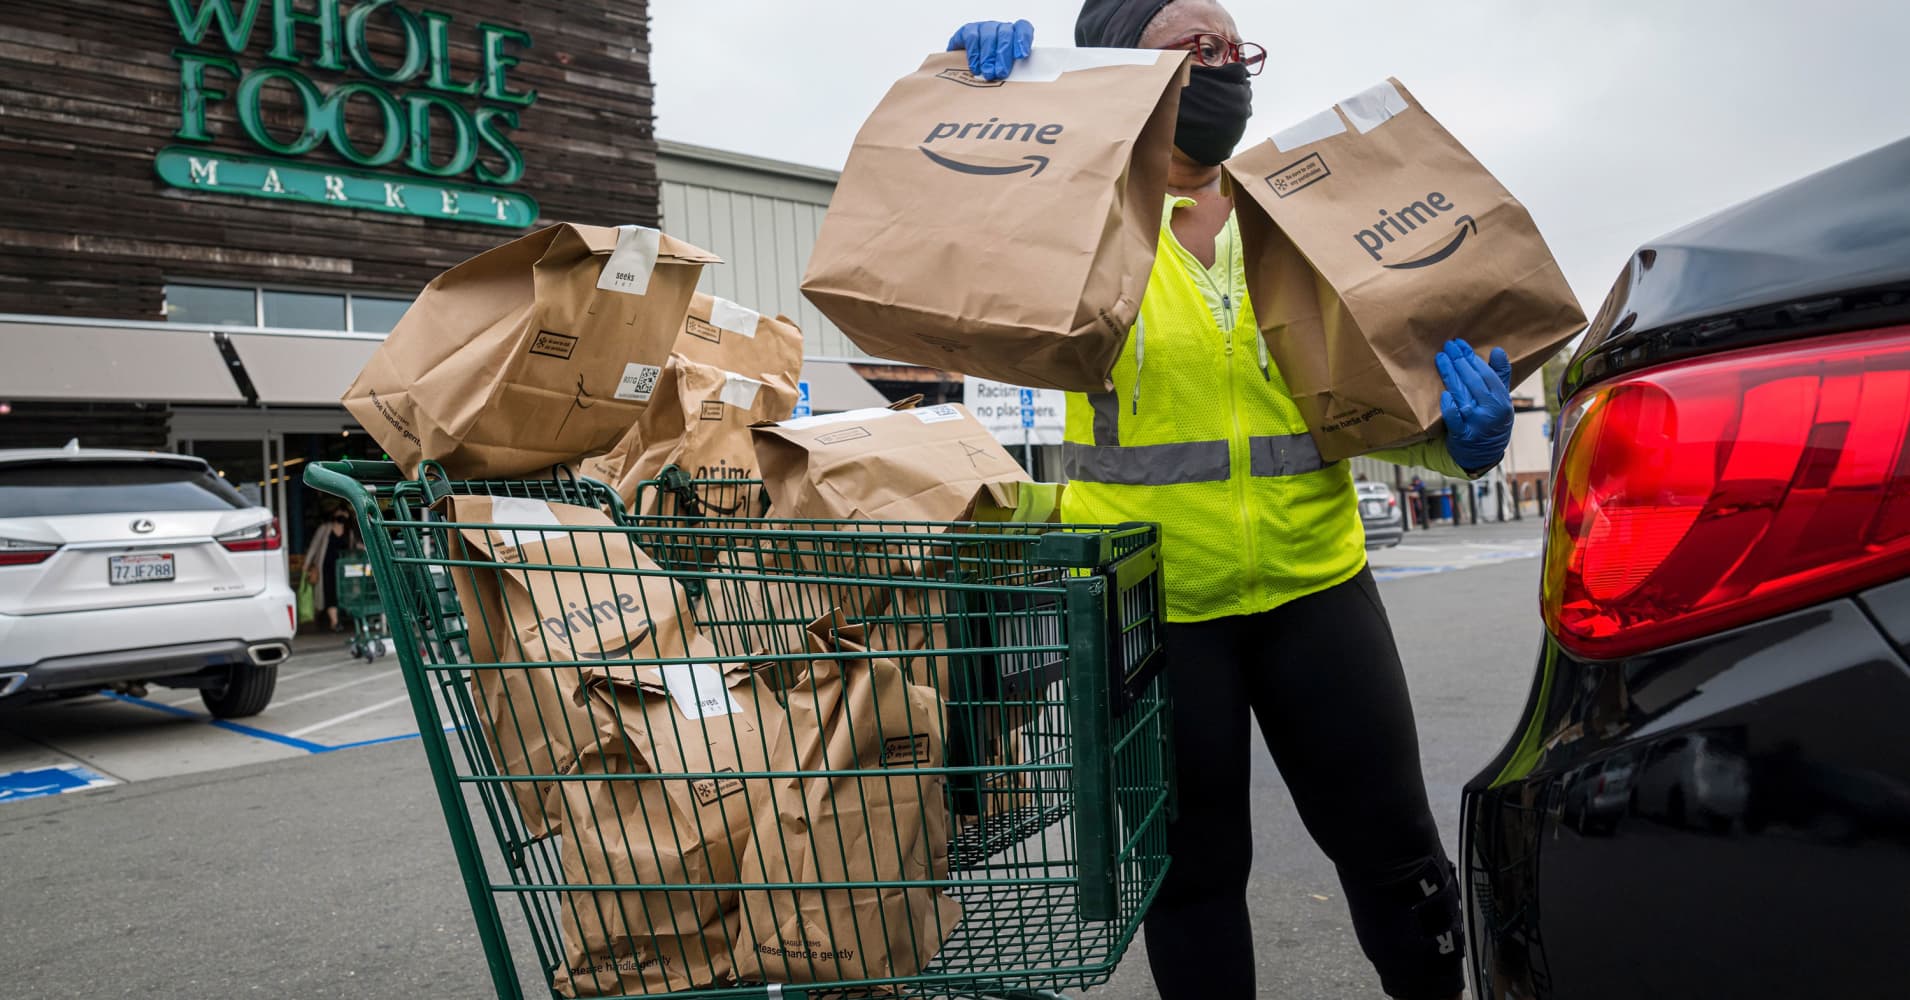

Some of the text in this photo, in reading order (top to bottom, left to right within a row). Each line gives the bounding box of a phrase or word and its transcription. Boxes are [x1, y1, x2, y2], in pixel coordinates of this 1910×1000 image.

[168, 0, 538, 106] WHOLE
[171, 48, 526, 184] FOODS
[924, 117, 1064, 144] prime
[187, 157, 511, 221] MARKET
[1354, 192, 1454, 261] prime
[382, 408, 403, 432] handle
[403, 430, 422, 449] gent
[977, 407, 993, 417] no
[997, 403, 1022, 419] plac
[1031, 404, 1057, 417] ere.
[543, 593, 640, 644] prime
[756, 942, 783, 957] lease
[1436, 930, 1455, 954] R
[605, 960, 637, 972] hndle
[640, 955, 671, 971] genly
